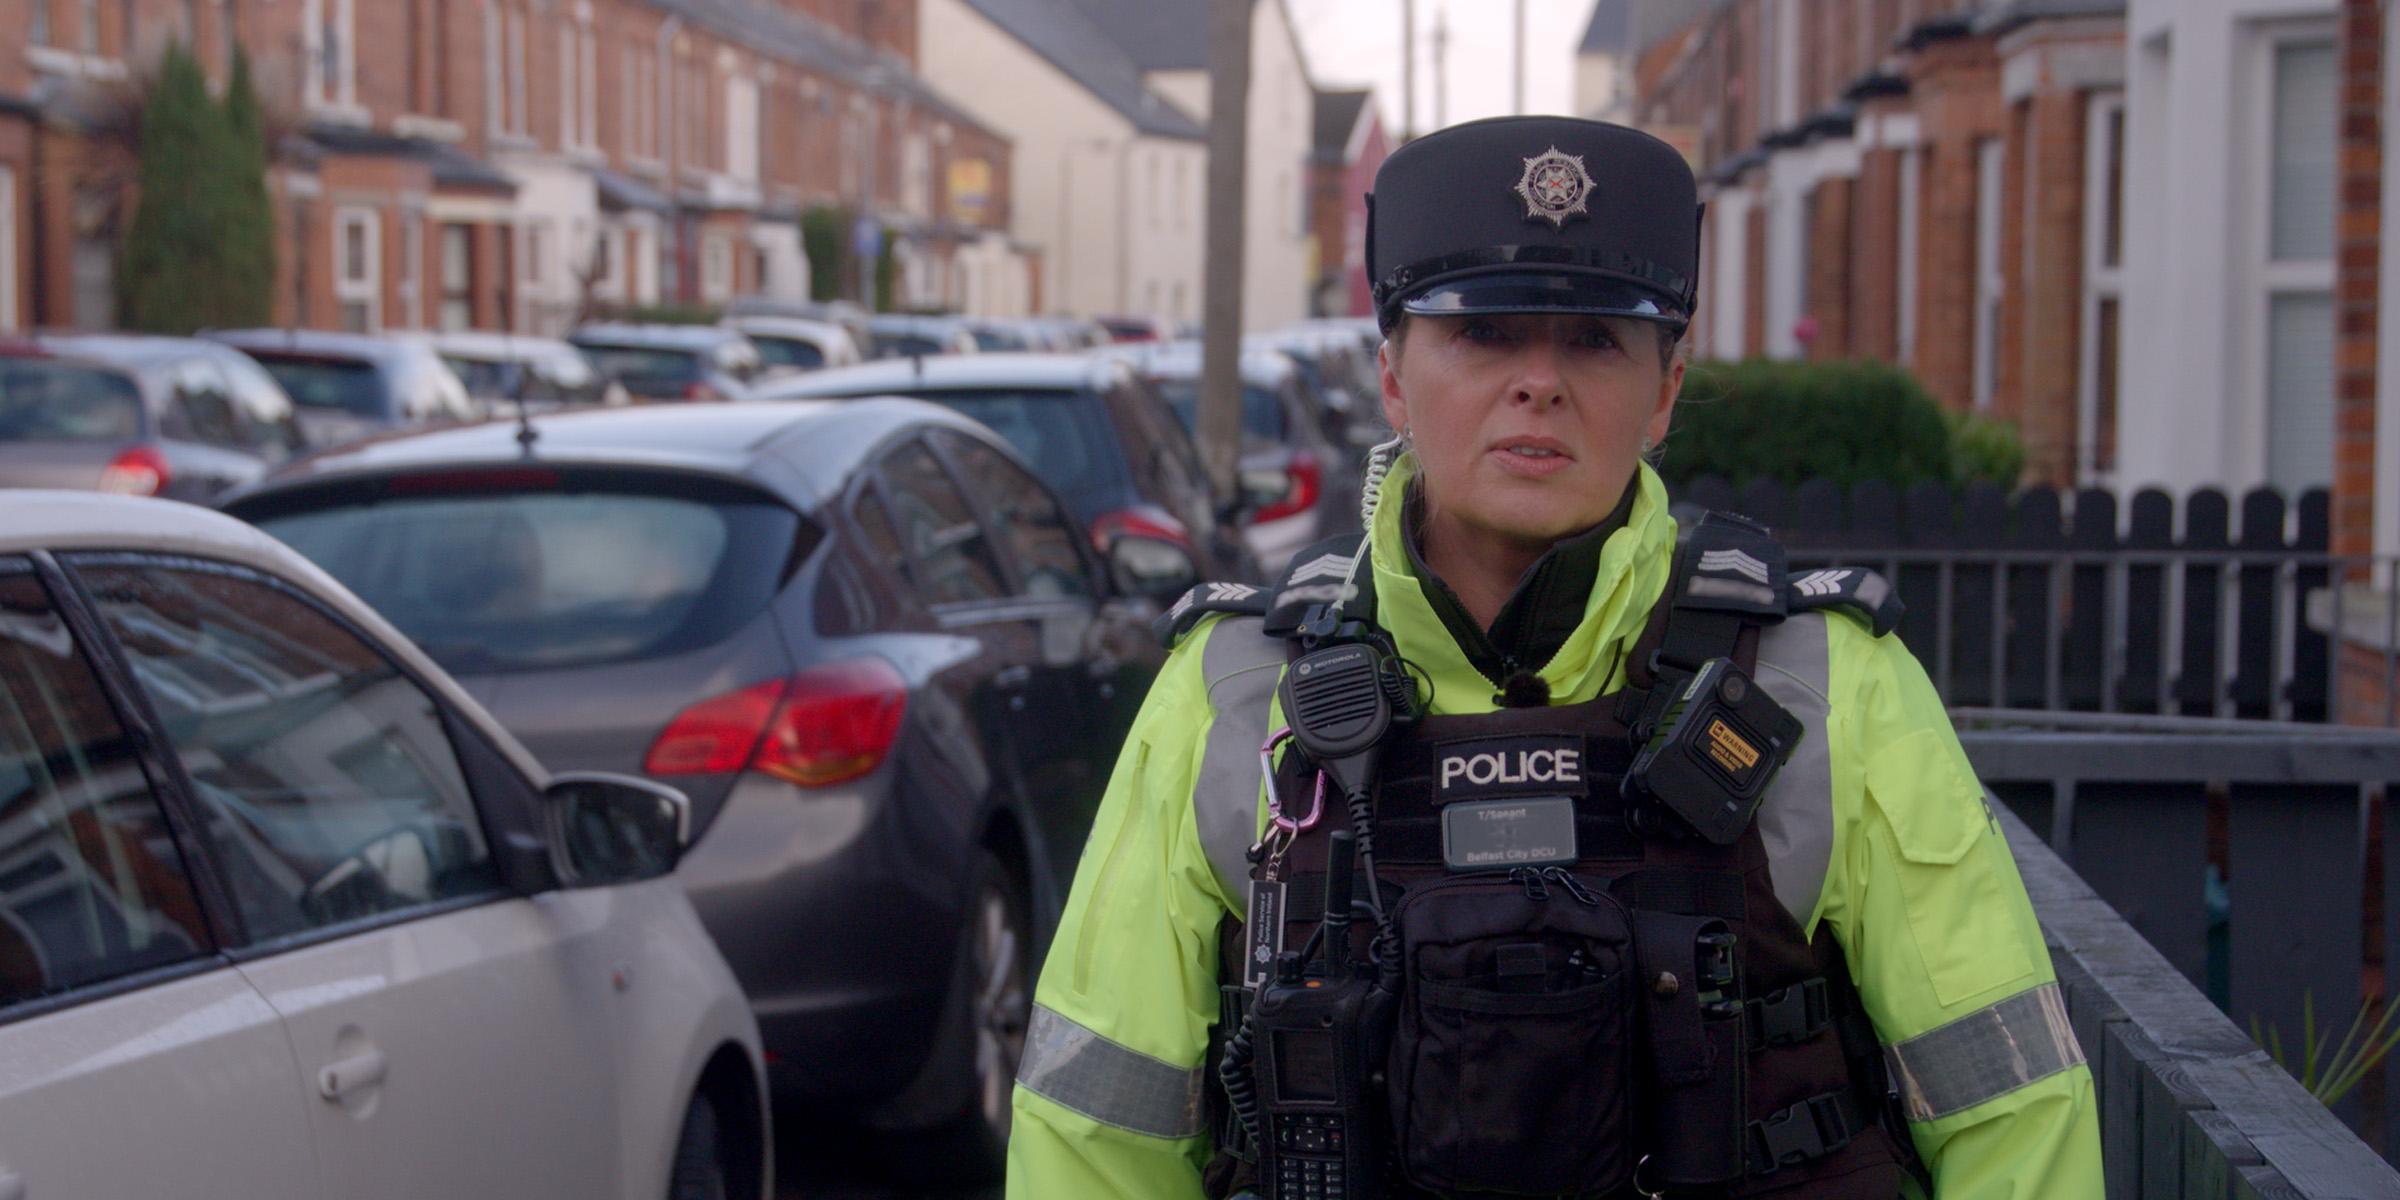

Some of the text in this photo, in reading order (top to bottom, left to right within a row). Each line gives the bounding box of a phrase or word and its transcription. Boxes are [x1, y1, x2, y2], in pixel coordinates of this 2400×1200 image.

[1314, 653, 1361, 668] MOTOROLA
[1722, 732, 1754, 762] WARNING
[1441, 749, 1580, 789] POLICE
[1466, 847, 1557, 863] Belfast City DCU
